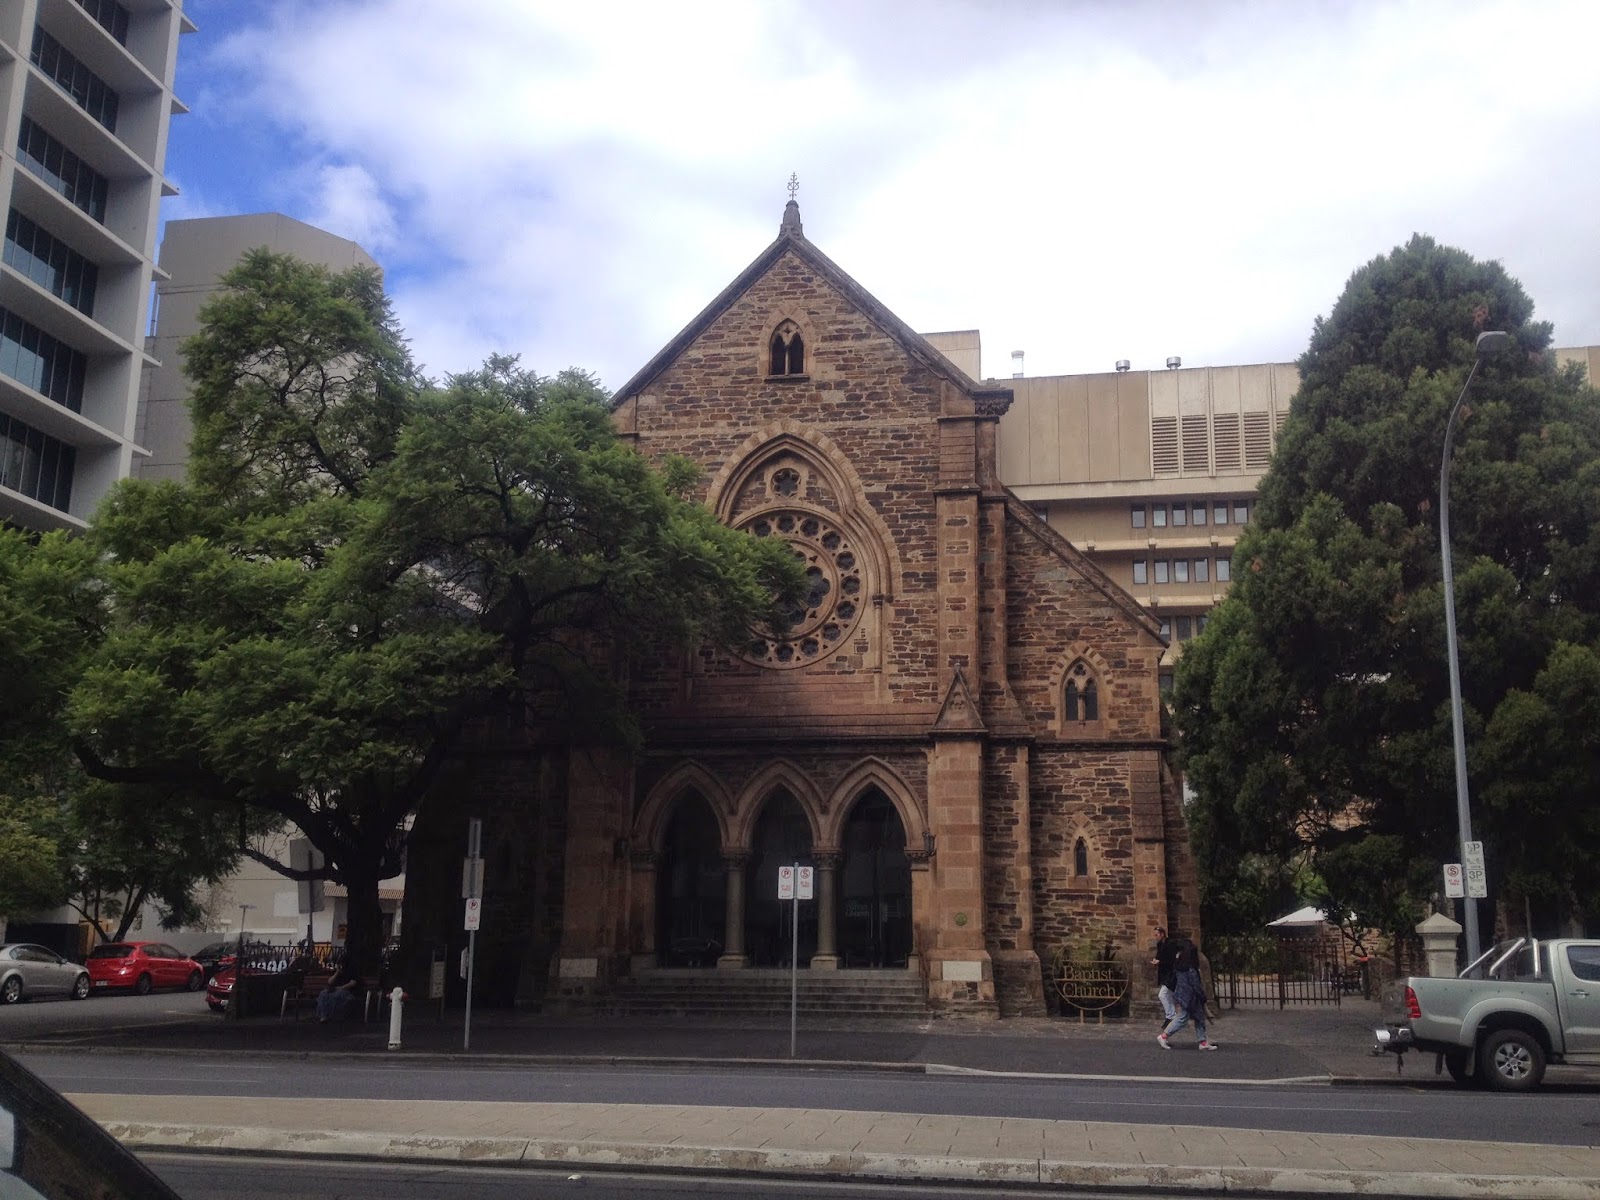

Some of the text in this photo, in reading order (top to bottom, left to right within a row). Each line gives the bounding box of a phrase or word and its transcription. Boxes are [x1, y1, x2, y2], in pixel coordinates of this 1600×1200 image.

[1469, 871, 1482, 879] 3P
[1063, 965, 1113, 983] Baptist
[1062, 982, 1116, 997] Church
